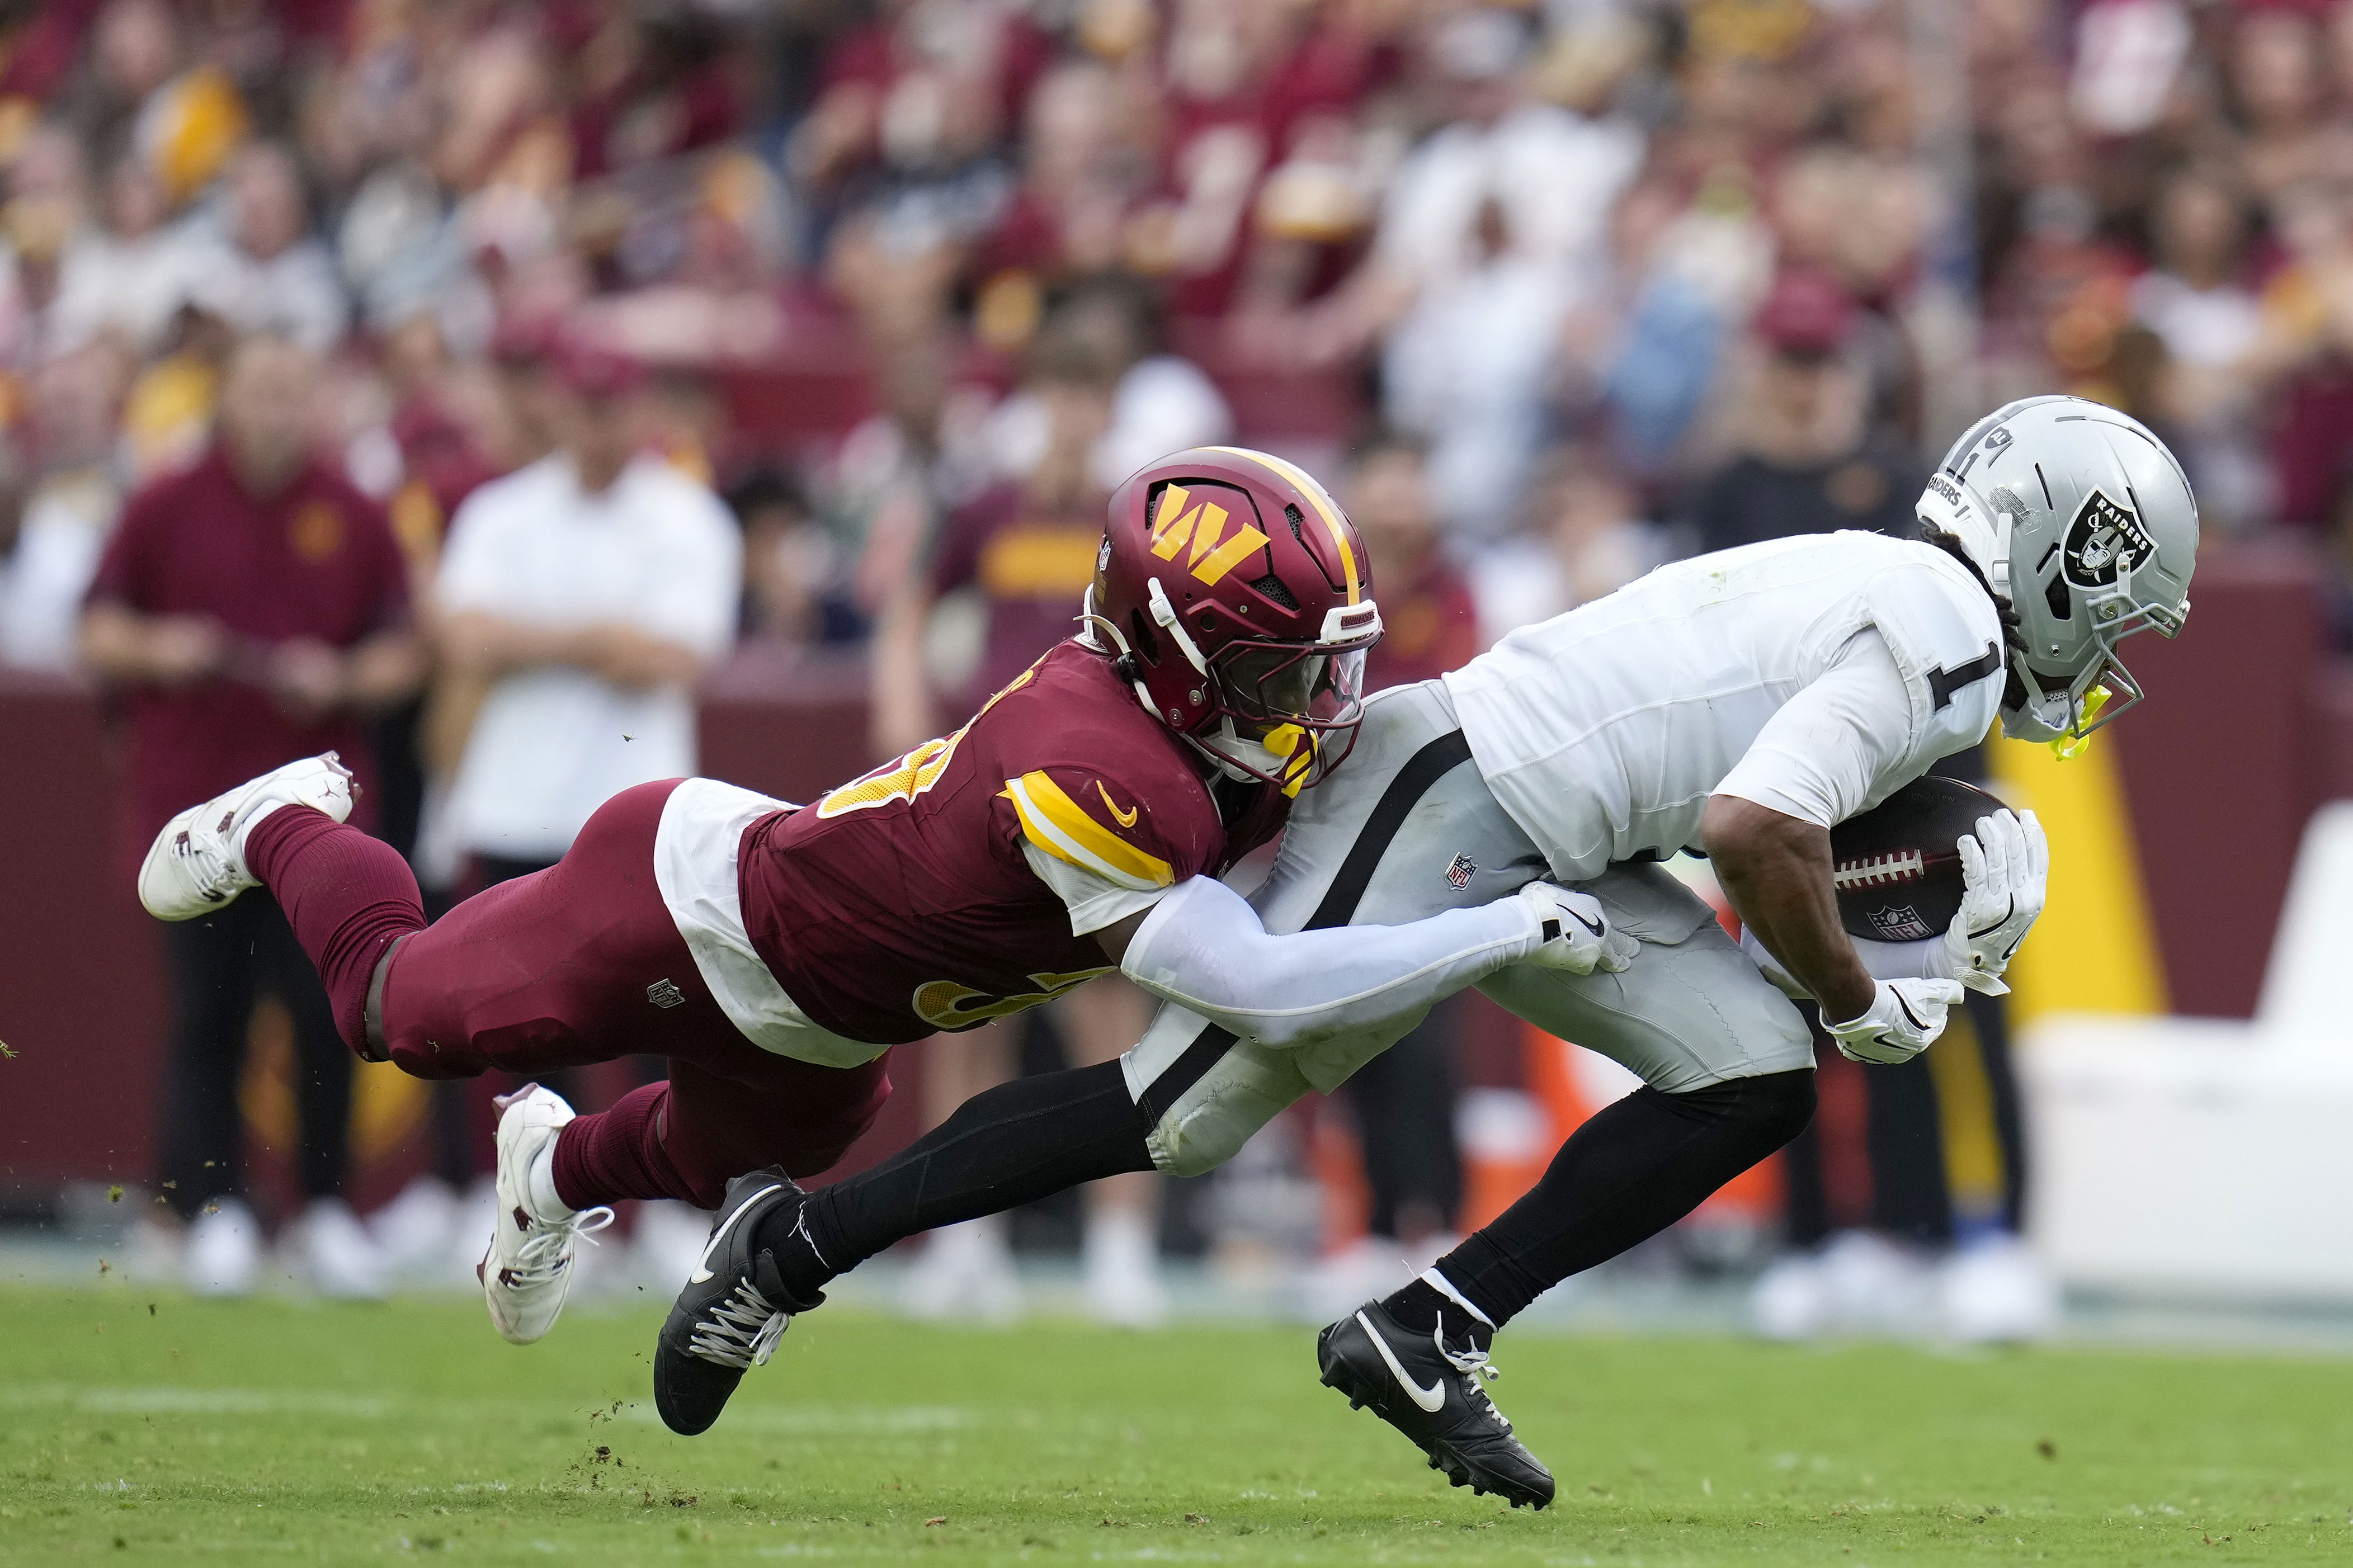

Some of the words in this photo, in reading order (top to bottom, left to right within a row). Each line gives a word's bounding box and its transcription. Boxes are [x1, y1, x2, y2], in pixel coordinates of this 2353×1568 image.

[1990, 430, 2007, 446] AL
[1960, 452, 1980, 478] 1
[1150, 482, 1271, 587] W
[2096, 498, 2148, 550] RAIDERS
[1925, 639, 2001, 714] 1
[1449, 866, 1468, 886] NFL
[1883, 924, 1925, 940] NFL
[651, 987, 671, 1004] NFL
